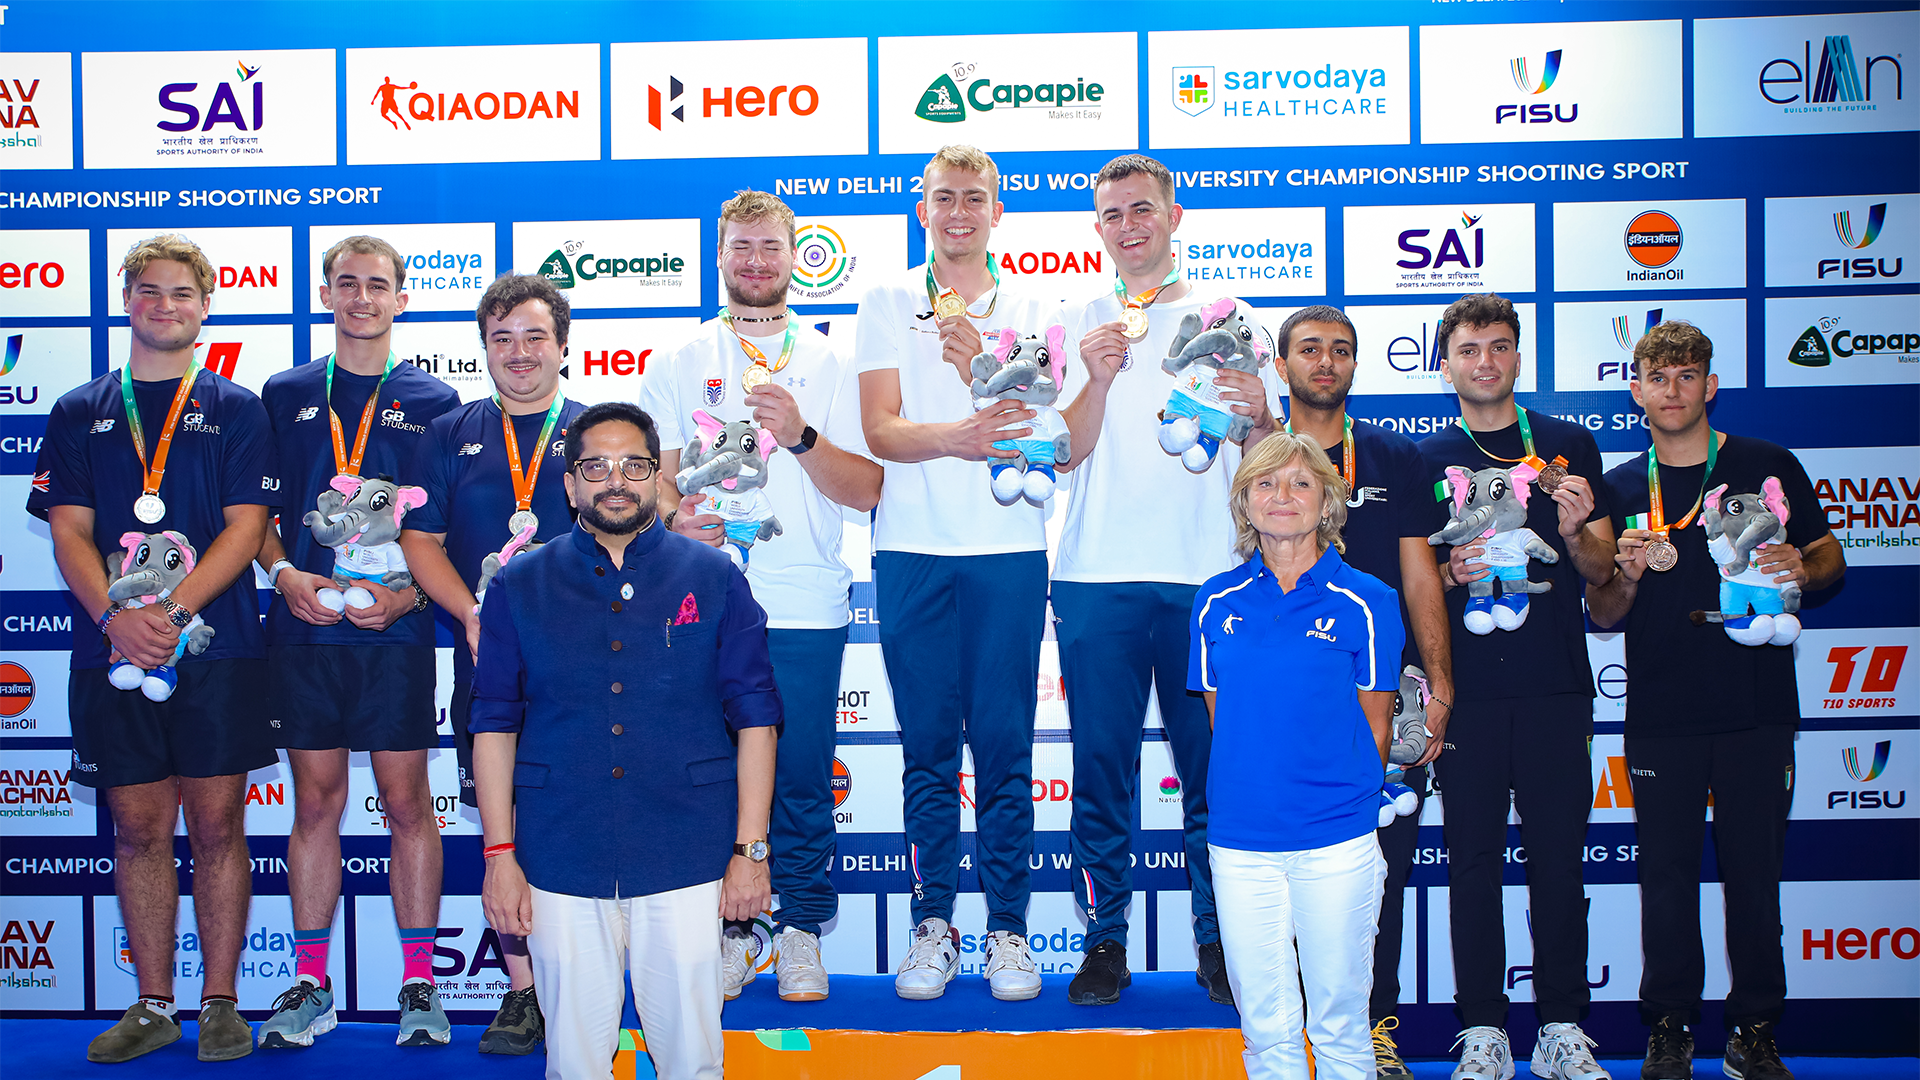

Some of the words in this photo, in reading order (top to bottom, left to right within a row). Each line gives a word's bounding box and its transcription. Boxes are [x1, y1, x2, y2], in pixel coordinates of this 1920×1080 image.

[1224, 64, 1386, 93] sarvodaya
[703, 85, 819, 117] Hero
[967, 77, 1104, 112] Capapie
[157, 82, 263, 132] SAI
[408, 91, 579, 121] QIAODAN
[1049, 111, 1074, 119] Makes
[1083, 110, 1102, 120] Easy
[1224, 98, 1386, 117] HEALTHCARE
[1496, 103, 1578, 124] FISU
[1783, 106, 1823, 114] BUILDING
[163, 136, 193, 146] भारतीय
[199, 136, 213, 146] खेल
[220, 135, 258, 145] प्राधिकरण
[1171, 170, 1280, 189] IVERSITY
[1286, 166, 1470, 187] CHAMPIONSHIP
[1477, 163, 1605, 183] SHOOTING
[1612, 161, 1689, 181] SPORT
[775, 178, 831, 196] NEW
[837, 177, 902, 194] DELHI
[178, 189, 302, 207] SHOOTING
[308, 187, 383, 205] SPORT
[1396, 228, 1484, 269] SAI
[1627, 233, 1679, 246] इंडियनऑयल
[1188, 239, 1312, 263] sarvodaya
[575, 252, 685, 281] Capapie
[1188, 266, 1313, 280] HEALTHCARE
[1400, 272, 1426, 280] भारतीय
[1430, 272, 1443, 280] खेल
[1627, 269, 1684, 281] IndianOil
[1818, 257, 1904, 279] FISU
[668, 279, 683, 287] Easy
[806, 281, 845, 299] ASSOCIATION
[842, 274, 851, 283] OF
[848, 256, 857, 273] INDIA
[448, 358, 483, 373] Ltd.
[381, 408, 406, 422] GB
[380, 419, 427, 435] STUDENTS
[1306, 630, 1337, 643] FISU
[1822, 698, 1844, 709] T10
[1848, 696, 1896, 708] SPORTS
[0, 788, 72, 804] CHNA
[1828, 789, 1906, 809] FISU
[843, 855, 907, 871] DELHI
[1803, 927, 1920, 961] Hero
[464, 979, 480, 989] खेल
